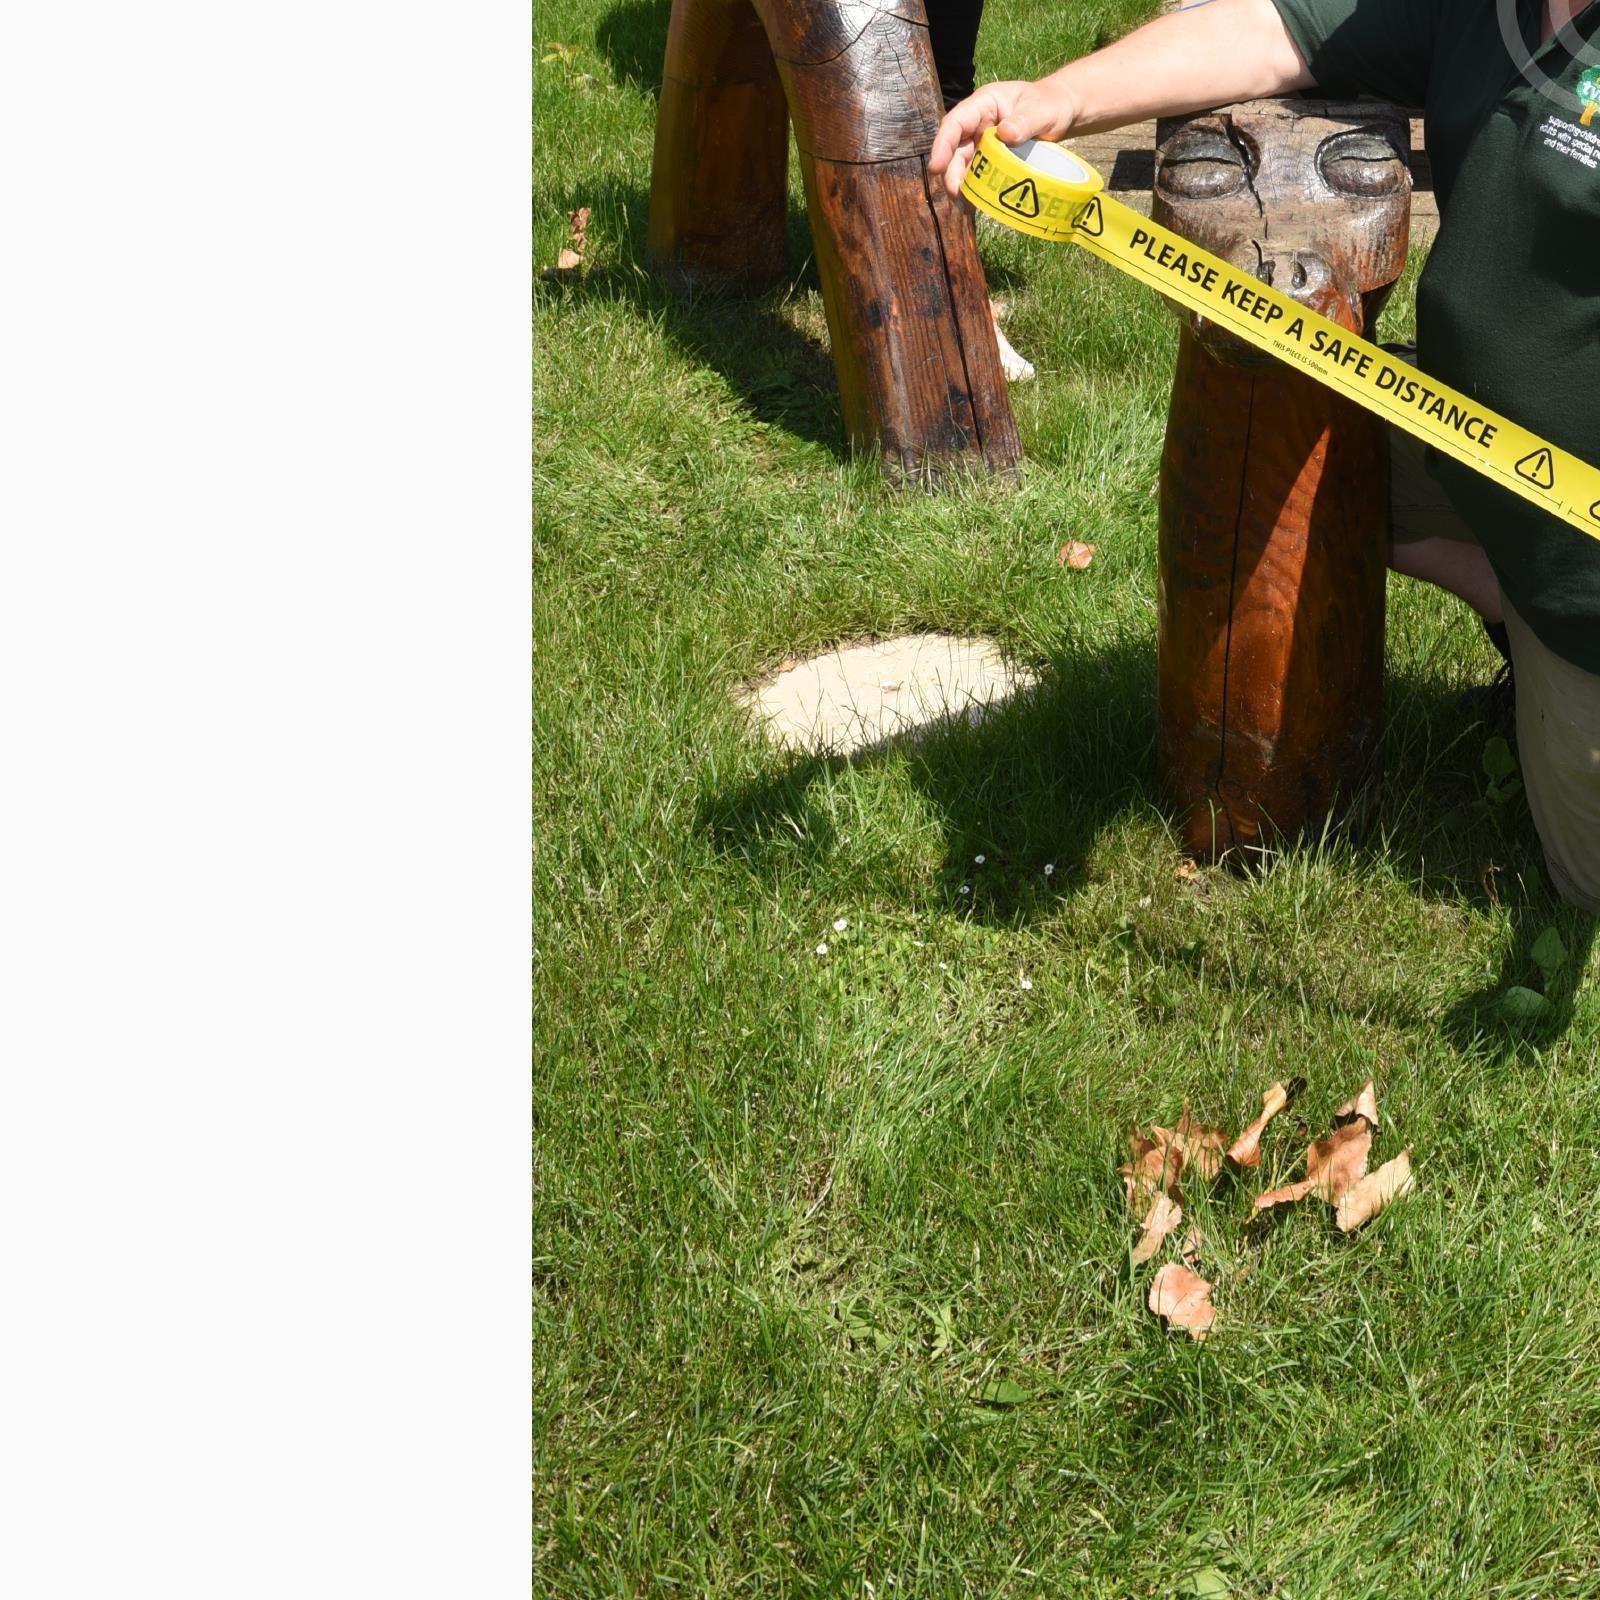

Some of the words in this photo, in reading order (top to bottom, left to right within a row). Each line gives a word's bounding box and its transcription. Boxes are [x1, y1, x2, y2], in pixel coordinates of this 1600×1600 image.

[1548, 115, 1580, 137] supporting
[1557, 132, 1572, 143] with
[1571, 139, 1594, 156] special
[1129, 228, 1220, 293] PLEASE
[1221, 278, 1284, 331] KEEP
[1285, 318, 1304, 342] A
[1309, 330, 1375, 379] SAFE
[1375, 366, 1499, 449] DISTANCE
[1272, 340, 1286, 351] THIS
[1285, 347, 1302, 360] PIECE
